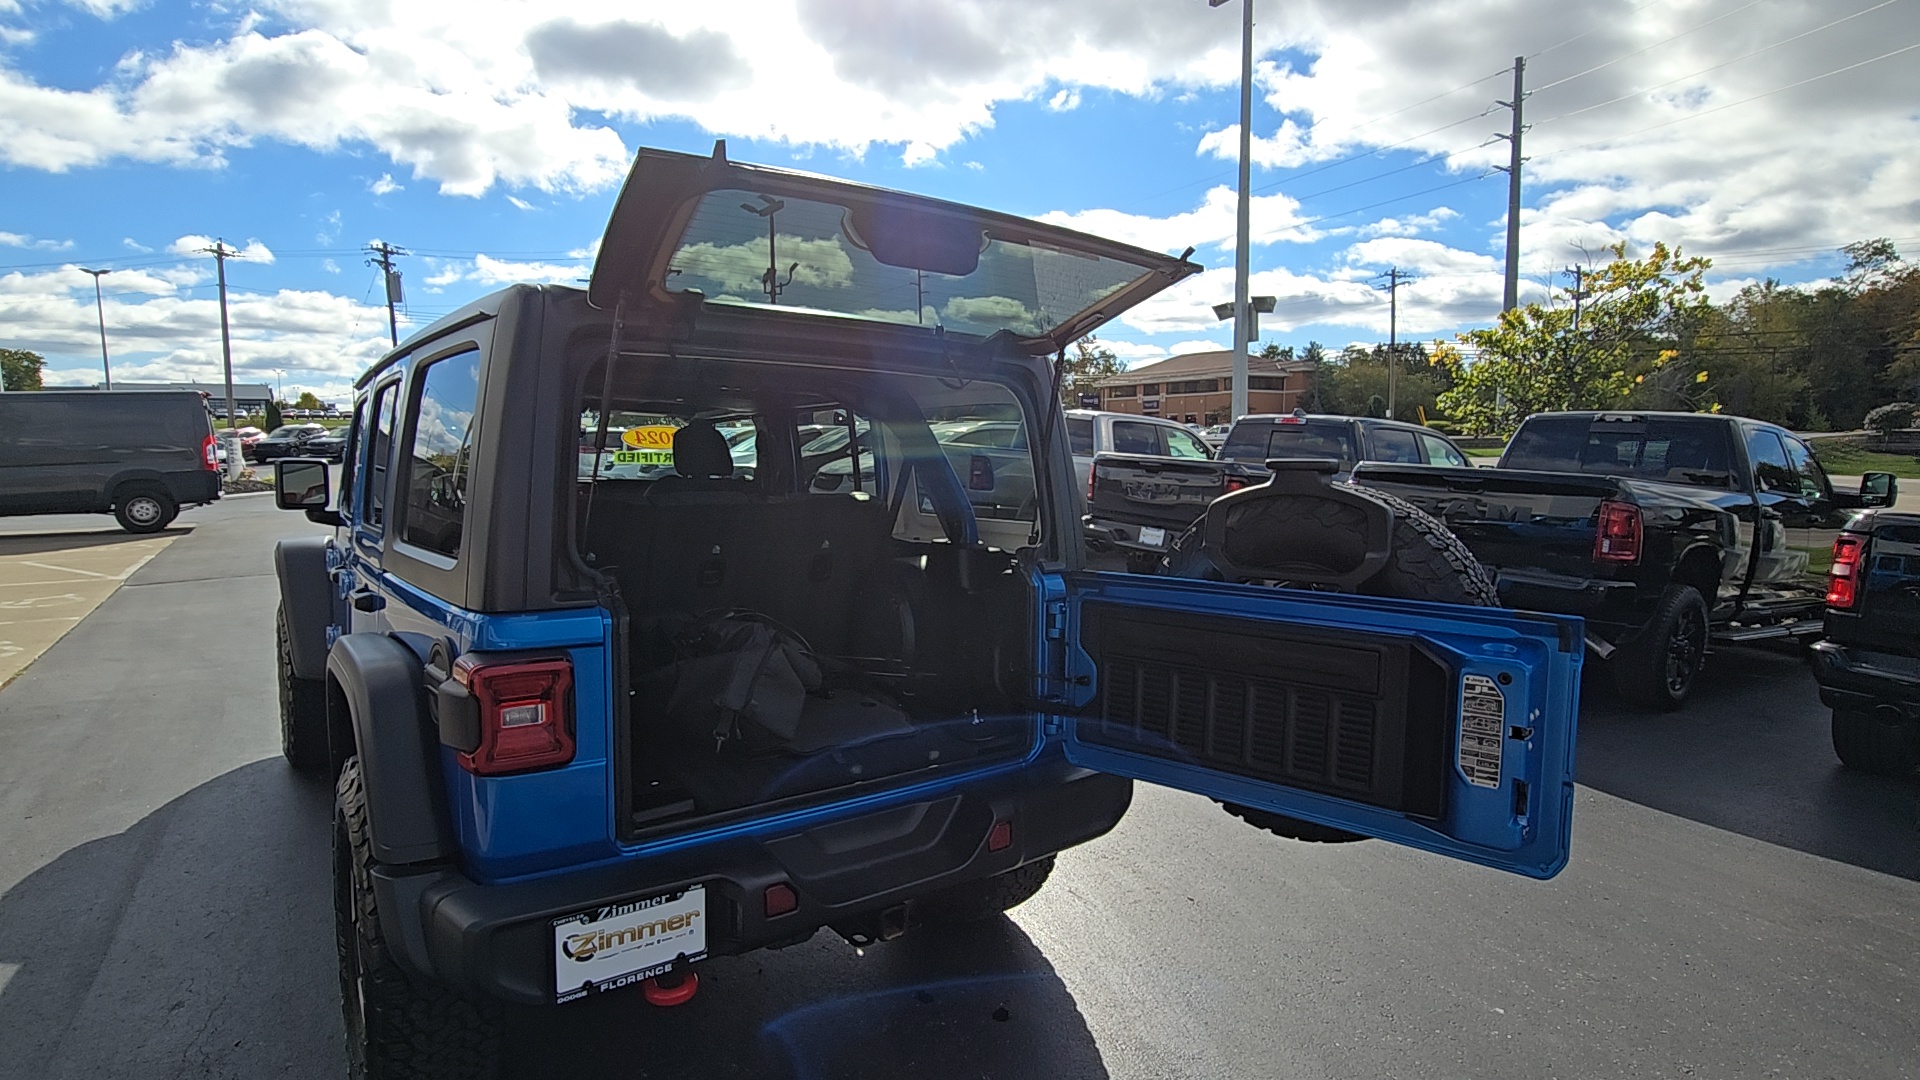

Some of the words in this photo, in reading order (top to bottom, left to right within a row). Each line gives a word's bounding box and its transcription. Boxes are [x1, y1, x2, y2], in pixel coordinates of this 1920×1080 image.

[1125, 482, 1180, 499] RAM
[1405, 495, 1533, 523] RAM
[598, 894, 670, 921] Zimmer
[571, 909, 701, 959] Zimmer
[600, 963, 673, 993] FLORENCE
[557, 991, 588, 1004] DODGE
